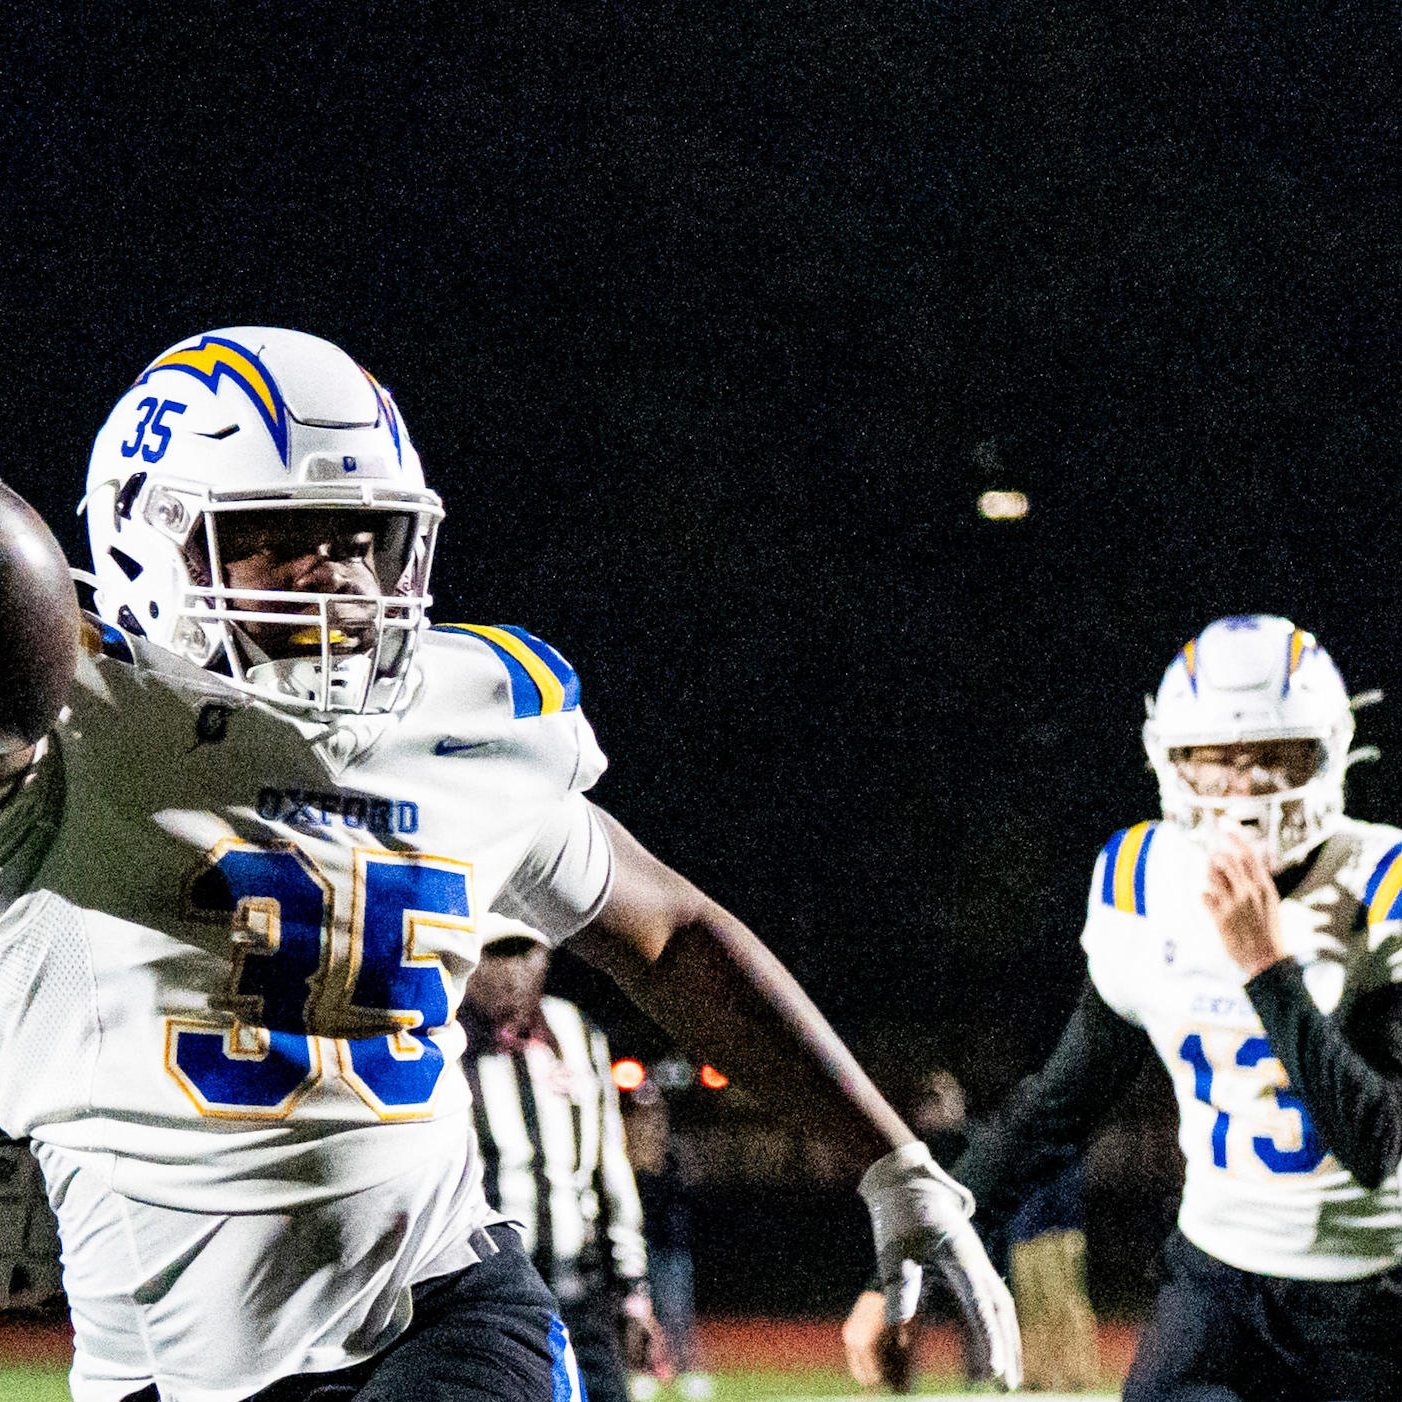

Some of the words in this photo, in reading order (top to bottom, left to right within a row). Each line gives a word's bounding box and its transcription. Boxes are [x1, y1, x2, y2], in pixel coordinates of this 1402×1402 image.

[121, 396, 188, 464] 35
[255, 786, 420, 835] OXFORD
[164, 837, 478, 1121] 35
[1175, 1026, 1335, 1179] 13
